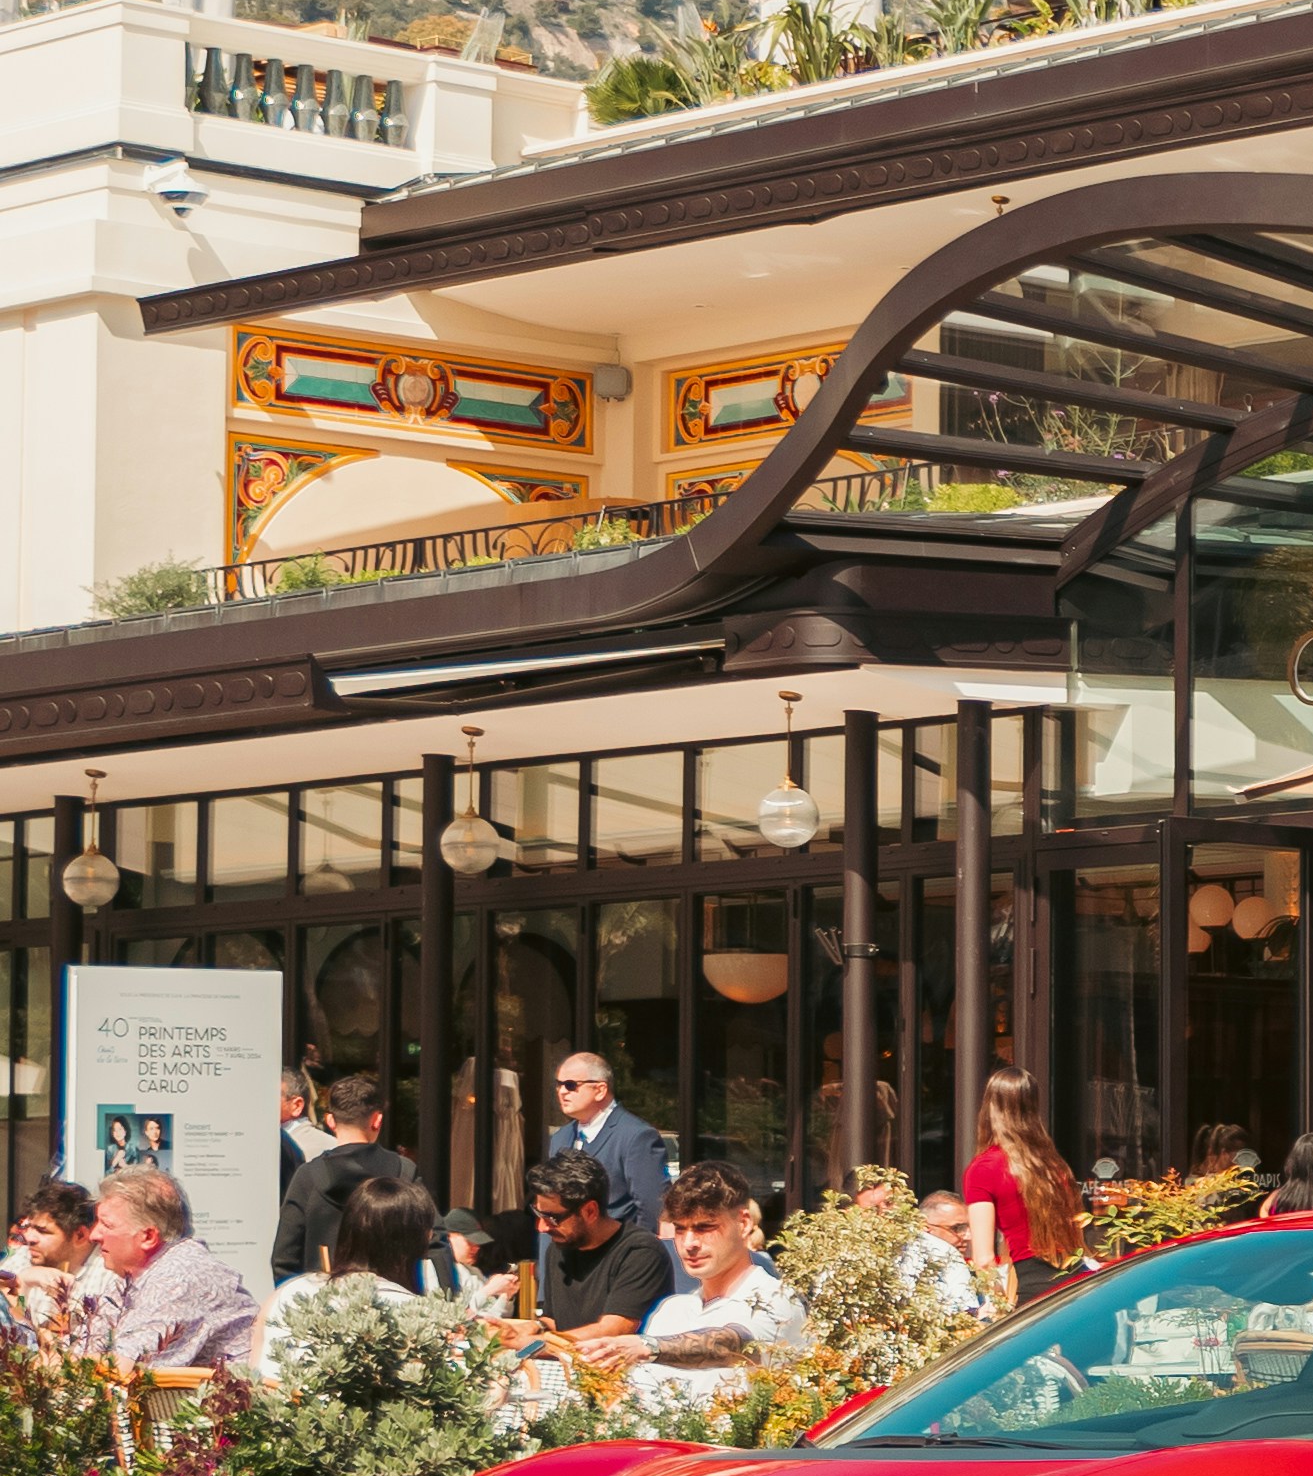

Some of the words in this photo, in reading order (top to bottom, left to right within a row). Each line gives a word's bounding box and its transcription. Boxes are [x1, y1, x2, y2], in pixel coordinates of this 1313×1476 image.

[97, 1017, 130, 1038] 40
[138, 1026, 227, 1042] PRINTEMPS
[138, 1043, 168, 1058] DES
[171, 1044, 211, 1059] ARTS
[138, 1062, 158, 1076] DE
[163, 1062, 231, 1076] MONTE-
[137, 1079, 190, 1093] CARLO
